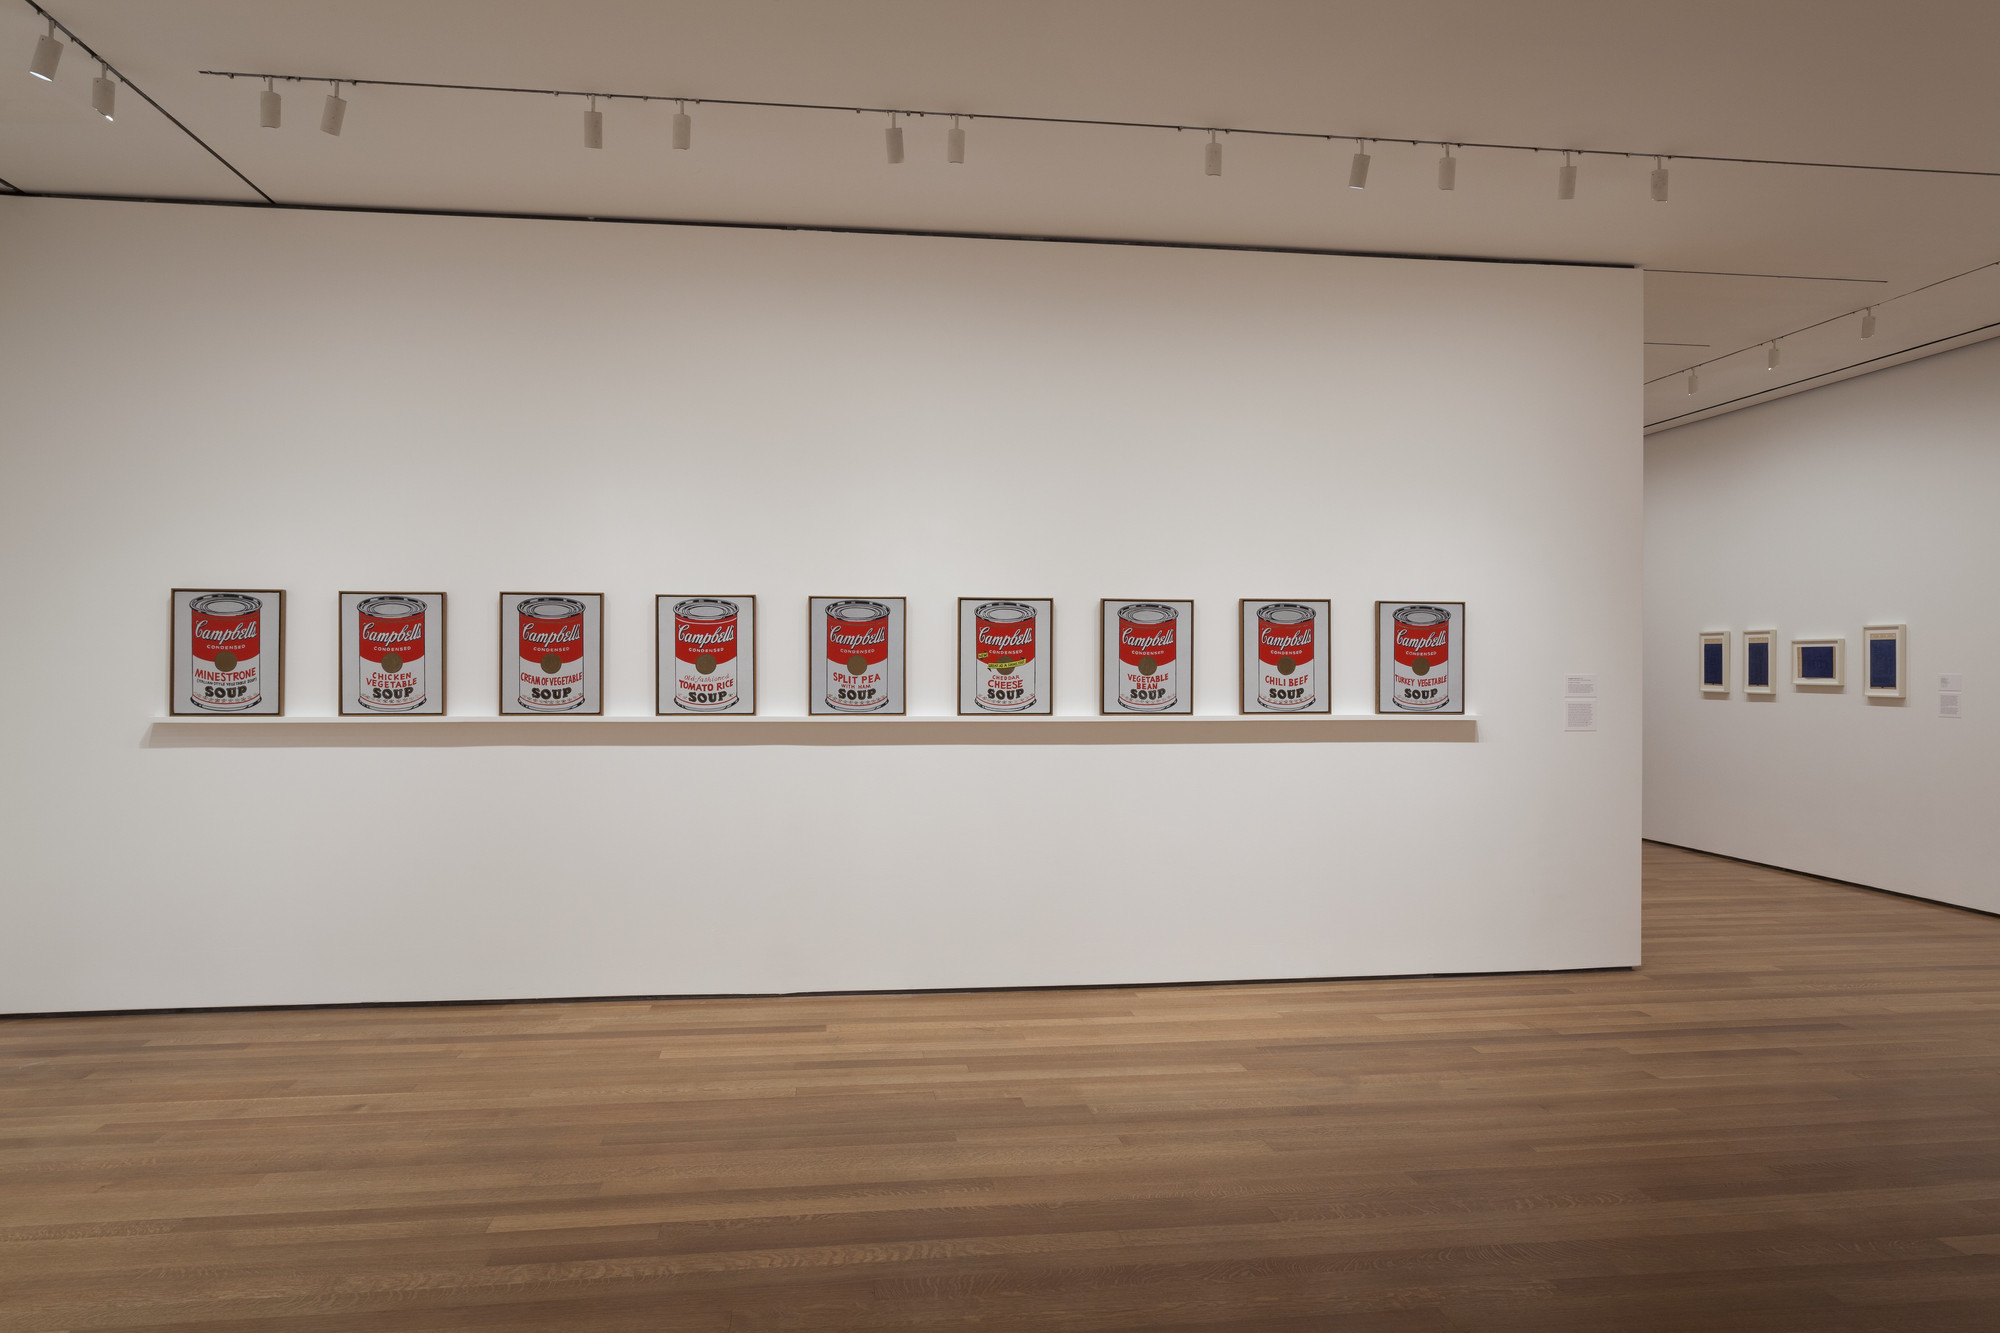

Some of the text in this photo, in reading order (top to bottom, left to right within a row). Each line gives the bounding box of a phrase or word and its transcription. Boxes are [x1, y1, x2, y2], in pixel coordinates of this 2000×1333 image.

[194, 667, 256, 682] MINESTRONE
[372, 671, 411, 681] CHICKEN
[520, 671, 583, 686] CREAM OF VEGETABLE
[832, 671, 881, 685] SPLIT PEA
[1127, 673, 1169, 684] VEGETABLE
[1264, 674, 1309, 687] CHILI BEEF
[1395, 673, 1448, 687] TURKEY VEGETABLE
[366, 677, 417, 689] VEGETABLE
[679, 678, 734, 692] TOMATO RICE
[987, 679, 1024, 690] CHEESE
[1136, 682, 1158, 690] BEAN
[205, 685, 247, 699] SOUP
[373, 686, 414, 700] SOUP
[531, 686, 572, 700] SOUP
[688, 690, 728, 703] SOUP
[838, 688, 877, 701] SOUP
[987, 688, 1025, 701] SOUP
[1130, 687, 1166, 701] SOUP
[1269, 687, 1305, 700] SOUP
[1404, 687, 1438, 700] SOUP
